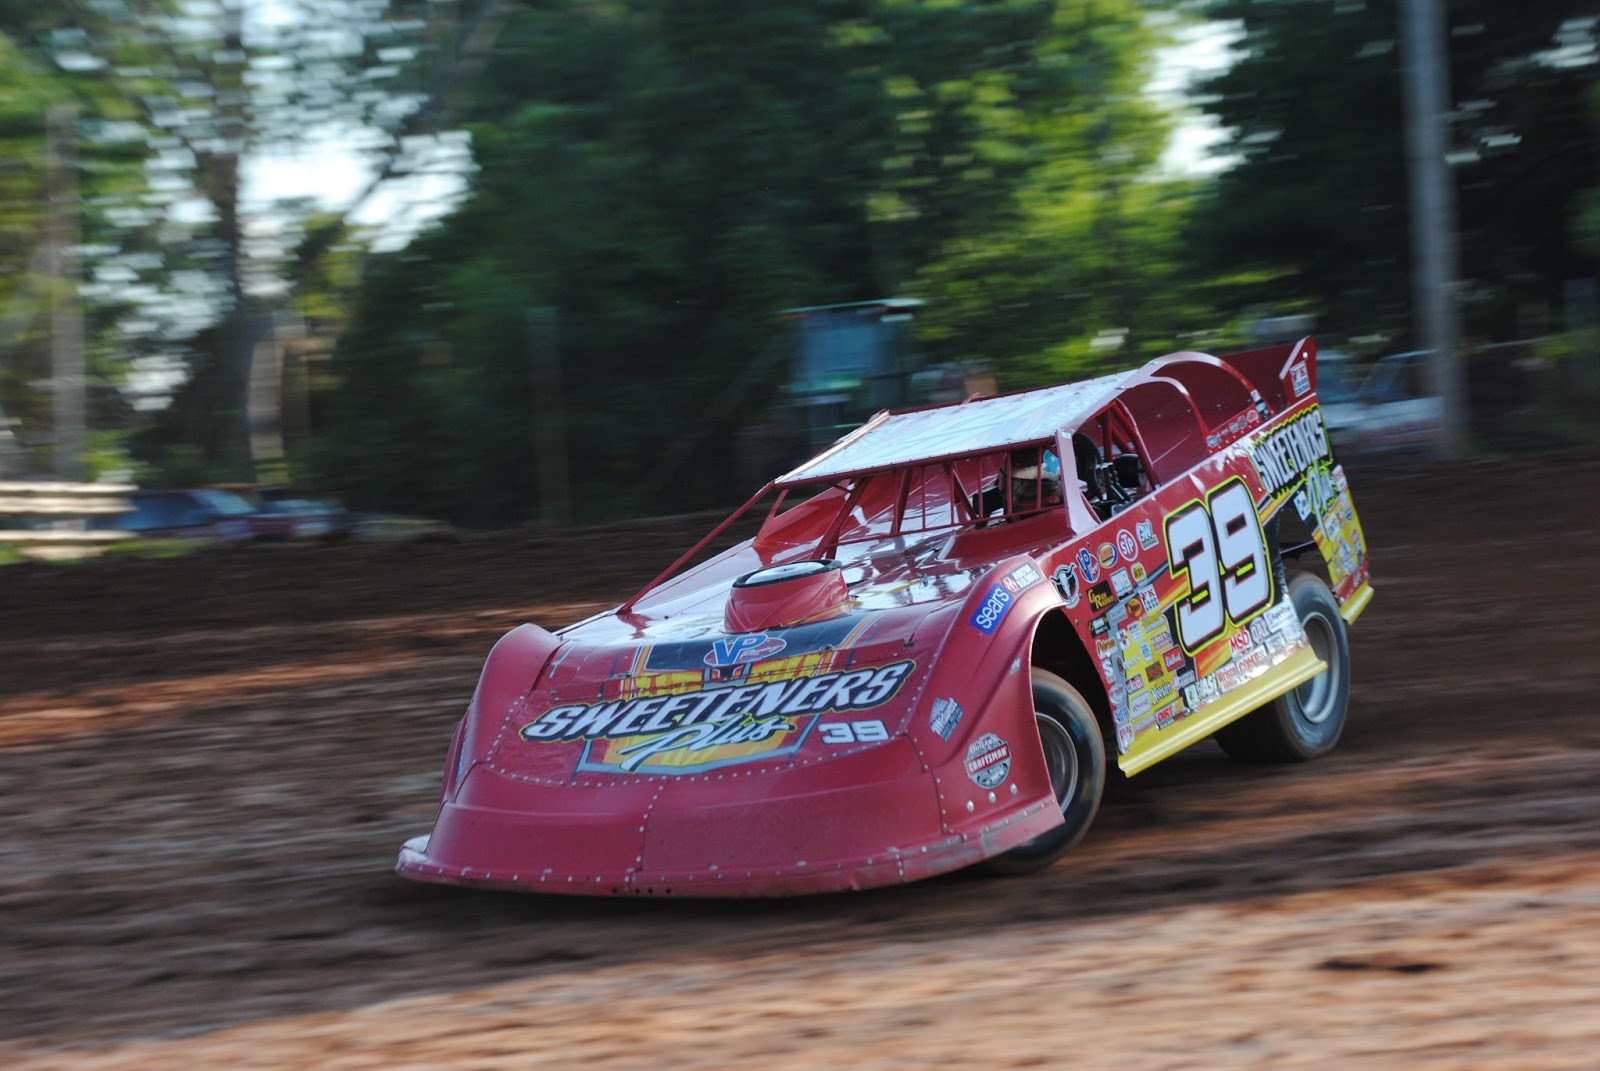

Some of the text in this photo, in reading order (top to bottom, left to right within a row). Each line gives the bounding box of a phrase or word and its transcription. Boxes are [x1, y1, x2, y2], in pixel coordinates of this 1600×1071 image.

[1251, 409, 1328, 494] SWEETENERS
[1120, 534, 1134, 555] STP
[1076, 549, 1093, 582] VP
[1167, 482, 1272, 650] 39
[976, 588, 1009, 629] sears
[713, 634, 768, 664] VP
[1231, 631, 1249, 653] MSD
[523, 661, 911, 739] SWEETENERS
[616, 713, 794, 773] Plus
[818, 720, 889, 744] 39
[968, 746, 1009, 773] CRAFTSMAN
